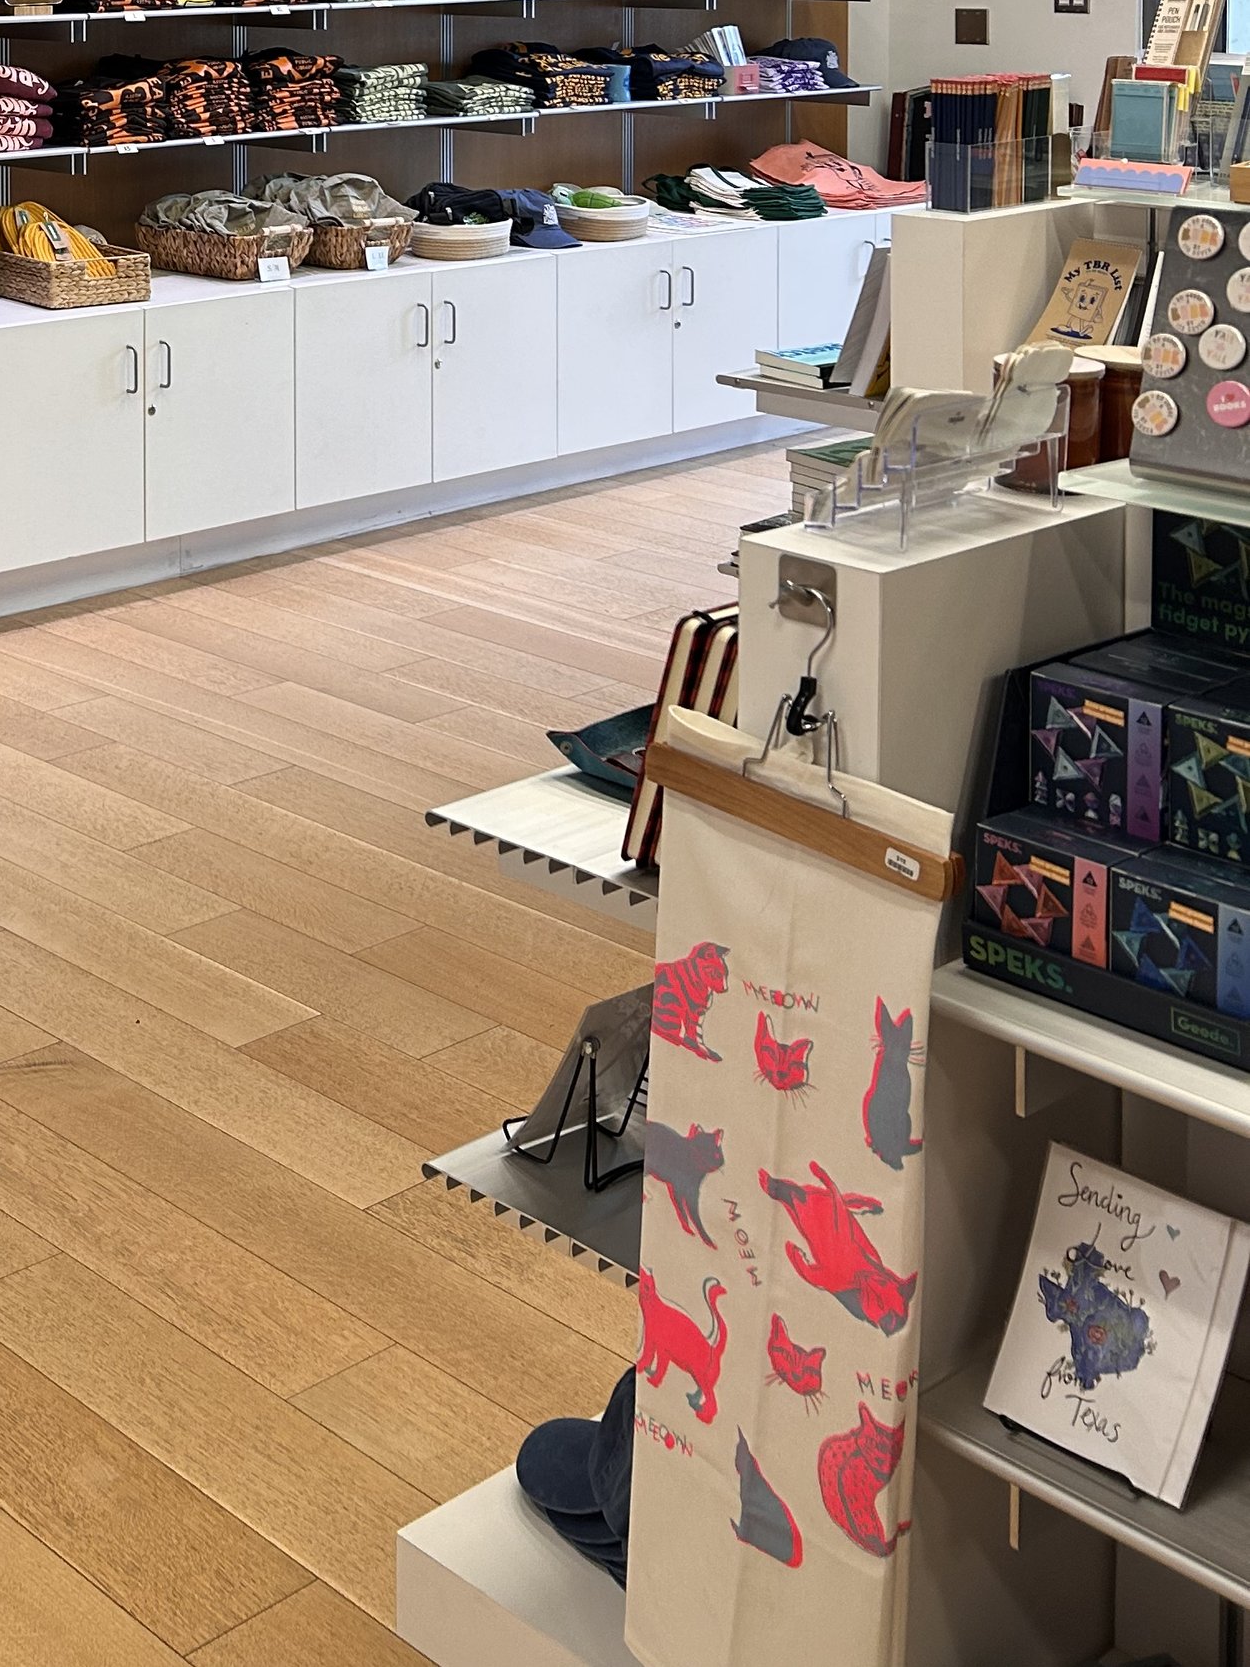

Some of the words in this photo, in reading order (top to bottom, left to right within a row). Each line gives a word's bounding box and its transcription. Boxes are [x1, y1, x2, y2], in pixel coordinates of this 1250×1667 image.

[1161, 15, 1182, 24] POUCH
[1168, 7, 1180, 15] PEN
[1064, 267, 1081, 283] My
[1084, 260, 1110, 271] TBR
[1109, 268, 1123, 291] List
[1213, 400, 1247, 412] BOOKS
[1158, 581, 1195, 605] The
[1159, 604, 1219, 633] fidget
[969, 935, 1074, 995] SPEKS.
[1058, 1162, 1157, 1251] Sending
[721, 1198, 763, 1287] MEOW
[1066, 1221, 1135, 1281] Love
[1065, 1394, 1122, 1443] Texas
